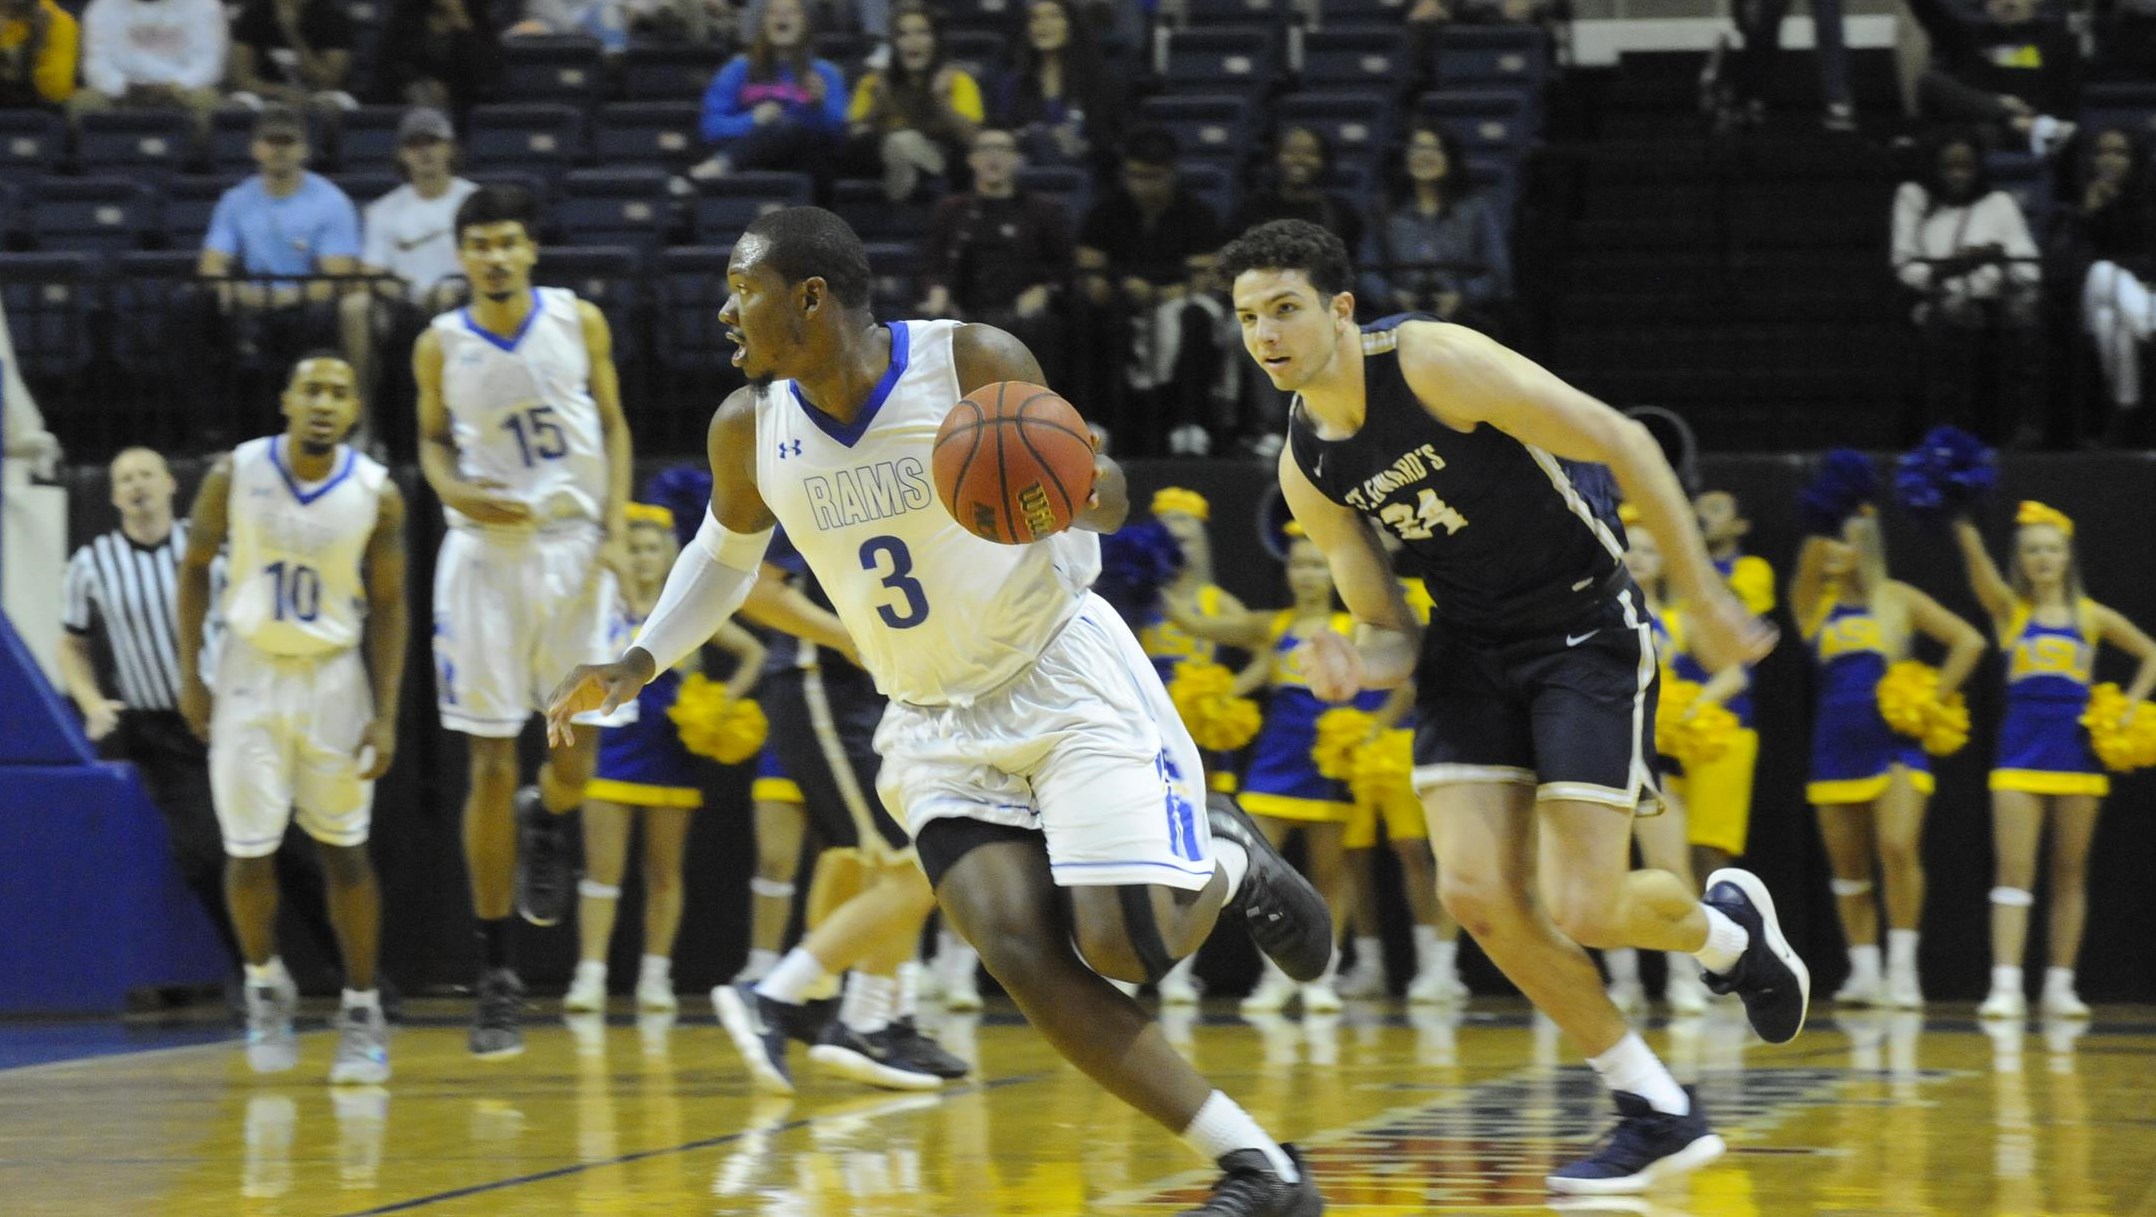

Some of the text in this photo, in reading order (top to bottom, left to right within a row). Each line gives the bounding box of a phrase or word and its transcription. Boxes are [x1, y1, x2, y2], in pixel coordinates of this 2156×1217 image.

[499, 405, 569, 468] 15
[804, 456, 932, 531] RAMS
[1380, 488, 1469, 540] 24
[260, 561, 322, 622] 10
[858, 535, 931, 629] 3
